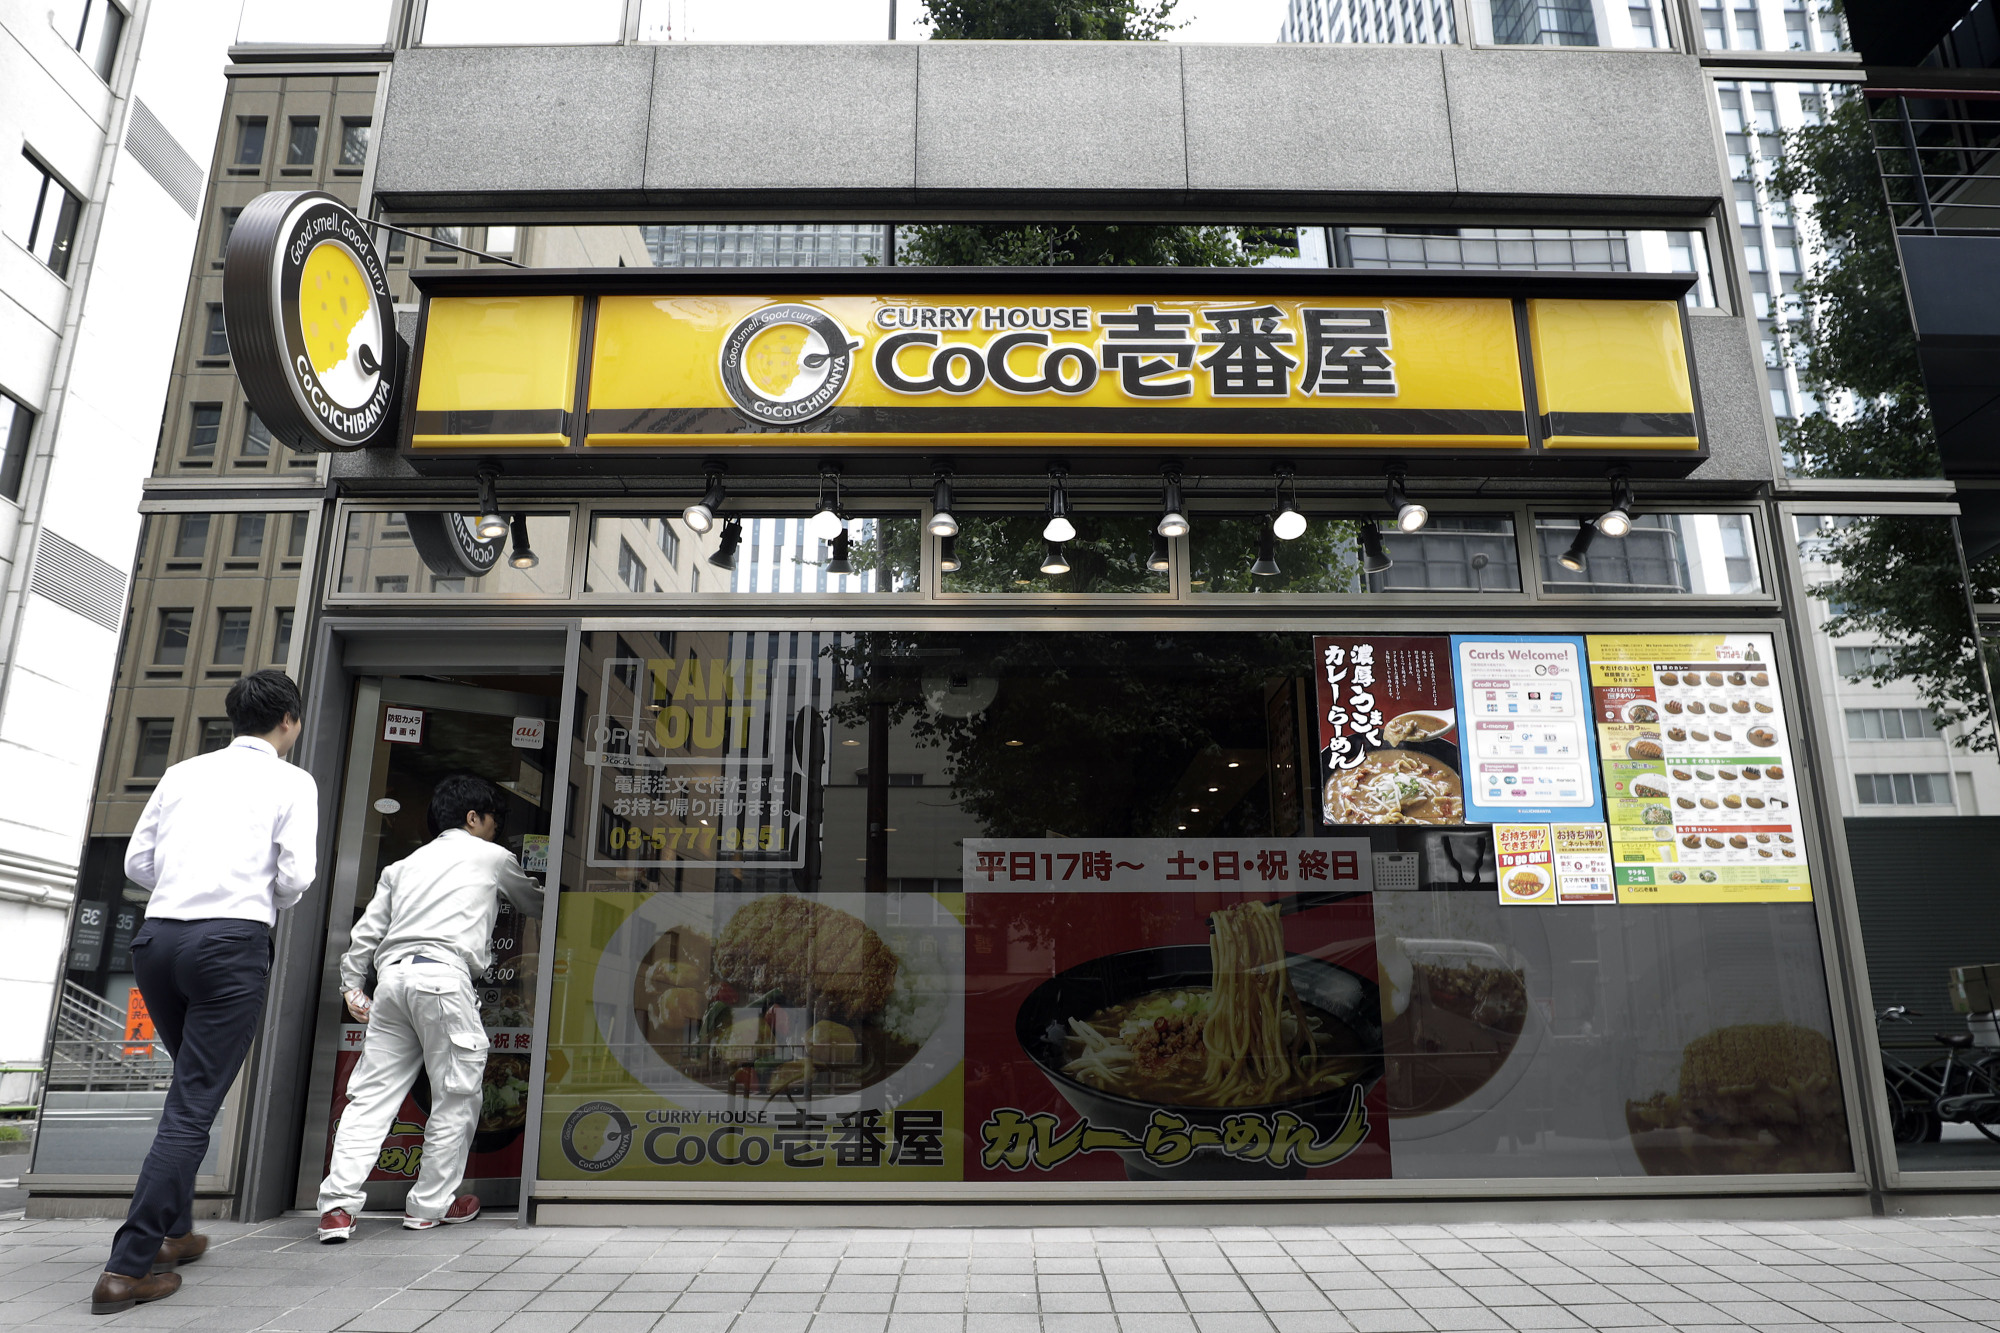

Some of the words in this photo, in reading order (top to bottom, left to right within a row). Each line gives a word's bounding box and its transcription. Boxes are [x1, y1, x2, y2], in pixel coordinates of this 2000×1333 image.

[291, 219, 313, 266] Good
[313, 212, 340, 236] smell.
[341, 219, 369, 257] Good
[366, 255, 386, 297] curry
[876, 307, 976, 328] CURRY
[984, 307, 1089, 329] HOUSE
[726, 341, 741, 368] Good
[737, 318, 762, 342] smell.
[761, 309, 789, 322] Good
[791, 310, 817, 325] curry
[874, 305, 1397, 398] CoCo壱番屋
[297, 354, 390, 434] CoCoICHIBANYA
[753, 355, 846, 418] CoCoICHIBANYA
[1469, 649, 1505, 660] Cards
[1508, 649, 1568, 660] Welcome!
[647, 658, 768, 700] TAKE
[387, 713, 421, 725] 防犯カメラ
[655, 705, 756, 749] OUT
[516, 726, 541, 738] au
[594, 727, 660, 748] OPEN
[614, 775, 785, 794] 電話注文で待たずに
[612, 798, 791, 818] お持ち帰り頂けます。
[609, 826, 785, 850] 03-5777-9551
[1500, 829, 1546, 842] お持ち帰り
[1557, 830, 1603, 840] お持ち帰り
[1298, 849, 1359, 882] 終日
[1502, 854, 1514, 866] To
[1515, 854, 1528, 867] go
[645, 1109, 700, 1124] CURRY
[706, 1109, 768, 1124] HOUSE
